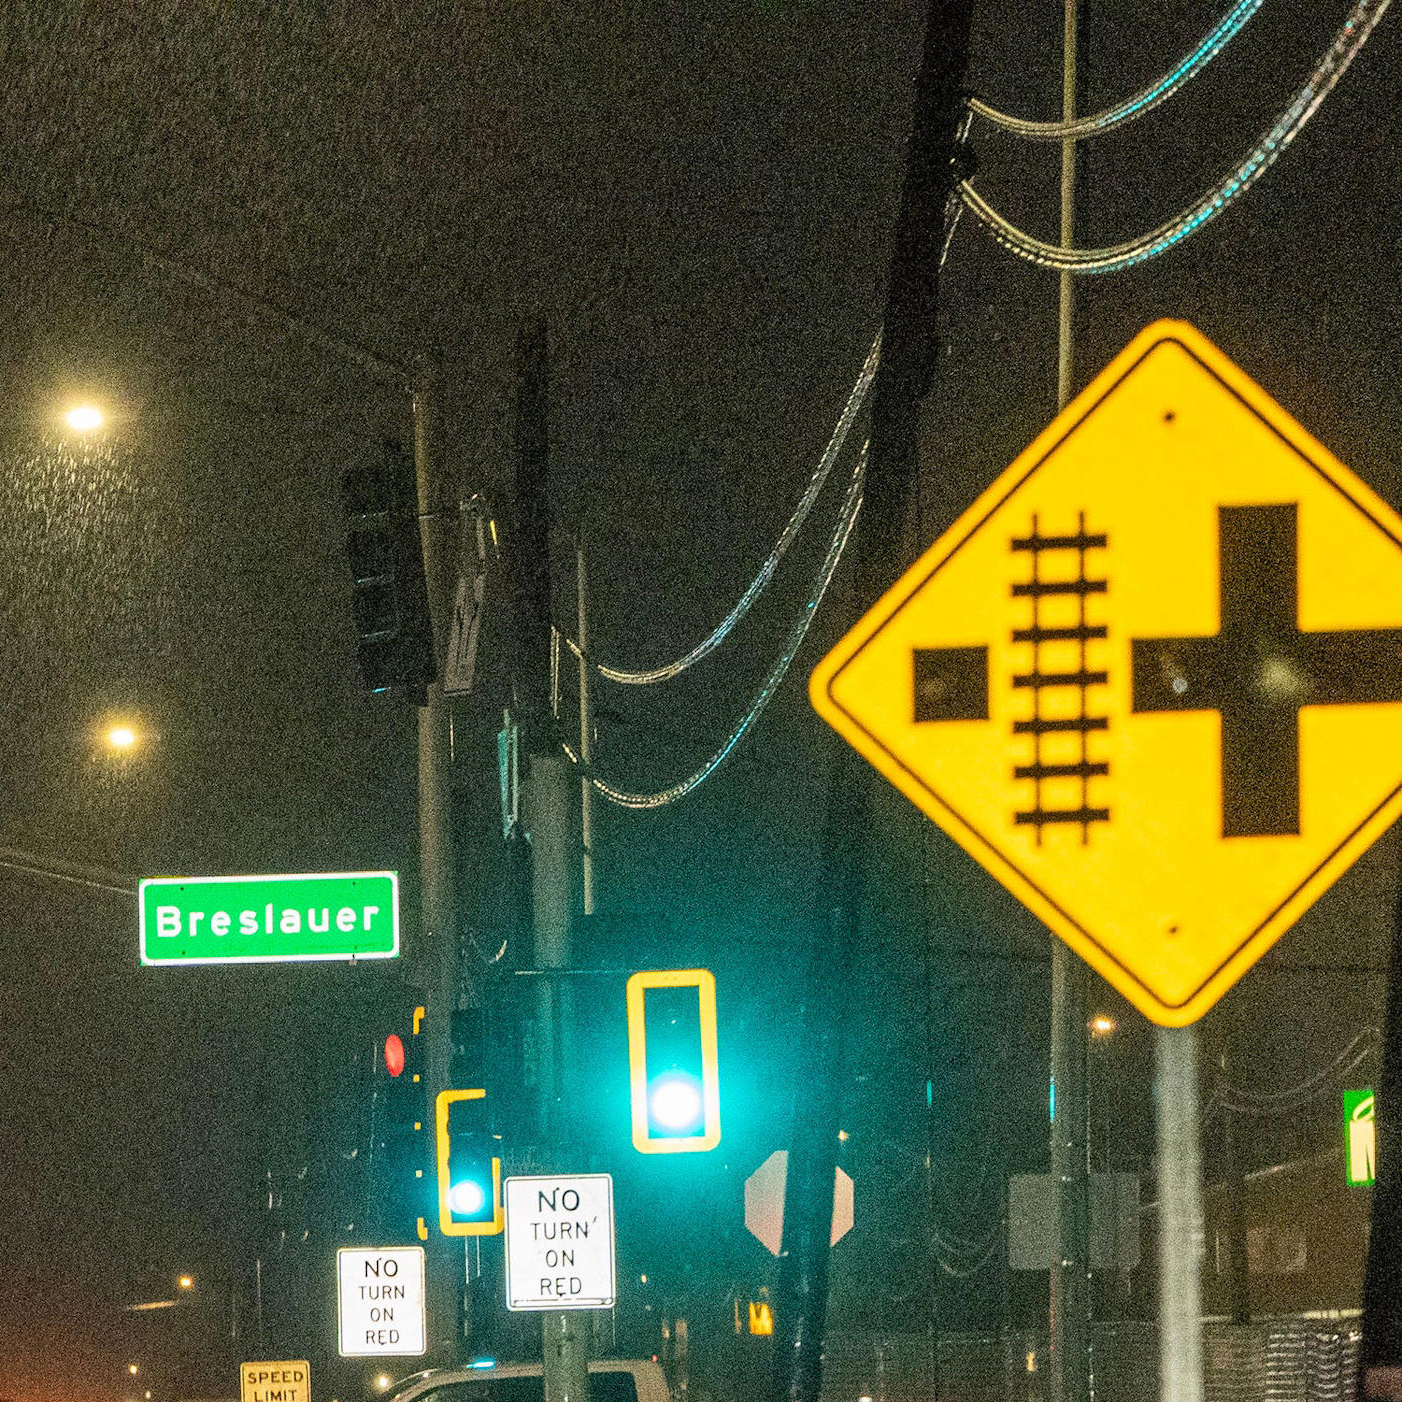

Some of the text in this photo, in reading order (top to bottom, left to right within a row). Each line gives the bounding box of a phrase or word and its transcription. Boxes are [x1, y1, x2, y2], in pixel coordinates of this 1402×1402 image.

[156, 903, 380, 938] Breslauer
[538, 1188, 581, 1212] NO
[530, 1222, 589, 1240] TURN
[545, 1250, 575, 1268] ON
[364, 1259, 399, 1278] NO
[358, 1285, 405, 1300] TURN
[540, 1277, 583, 1296] RED
[369, 1307, 394, 1323] ON
[365, 1329, 400, 1345] RED
[247, 1370, 304, 1385] SPEED
[254, 1389, 297, 1402] LIMIT
